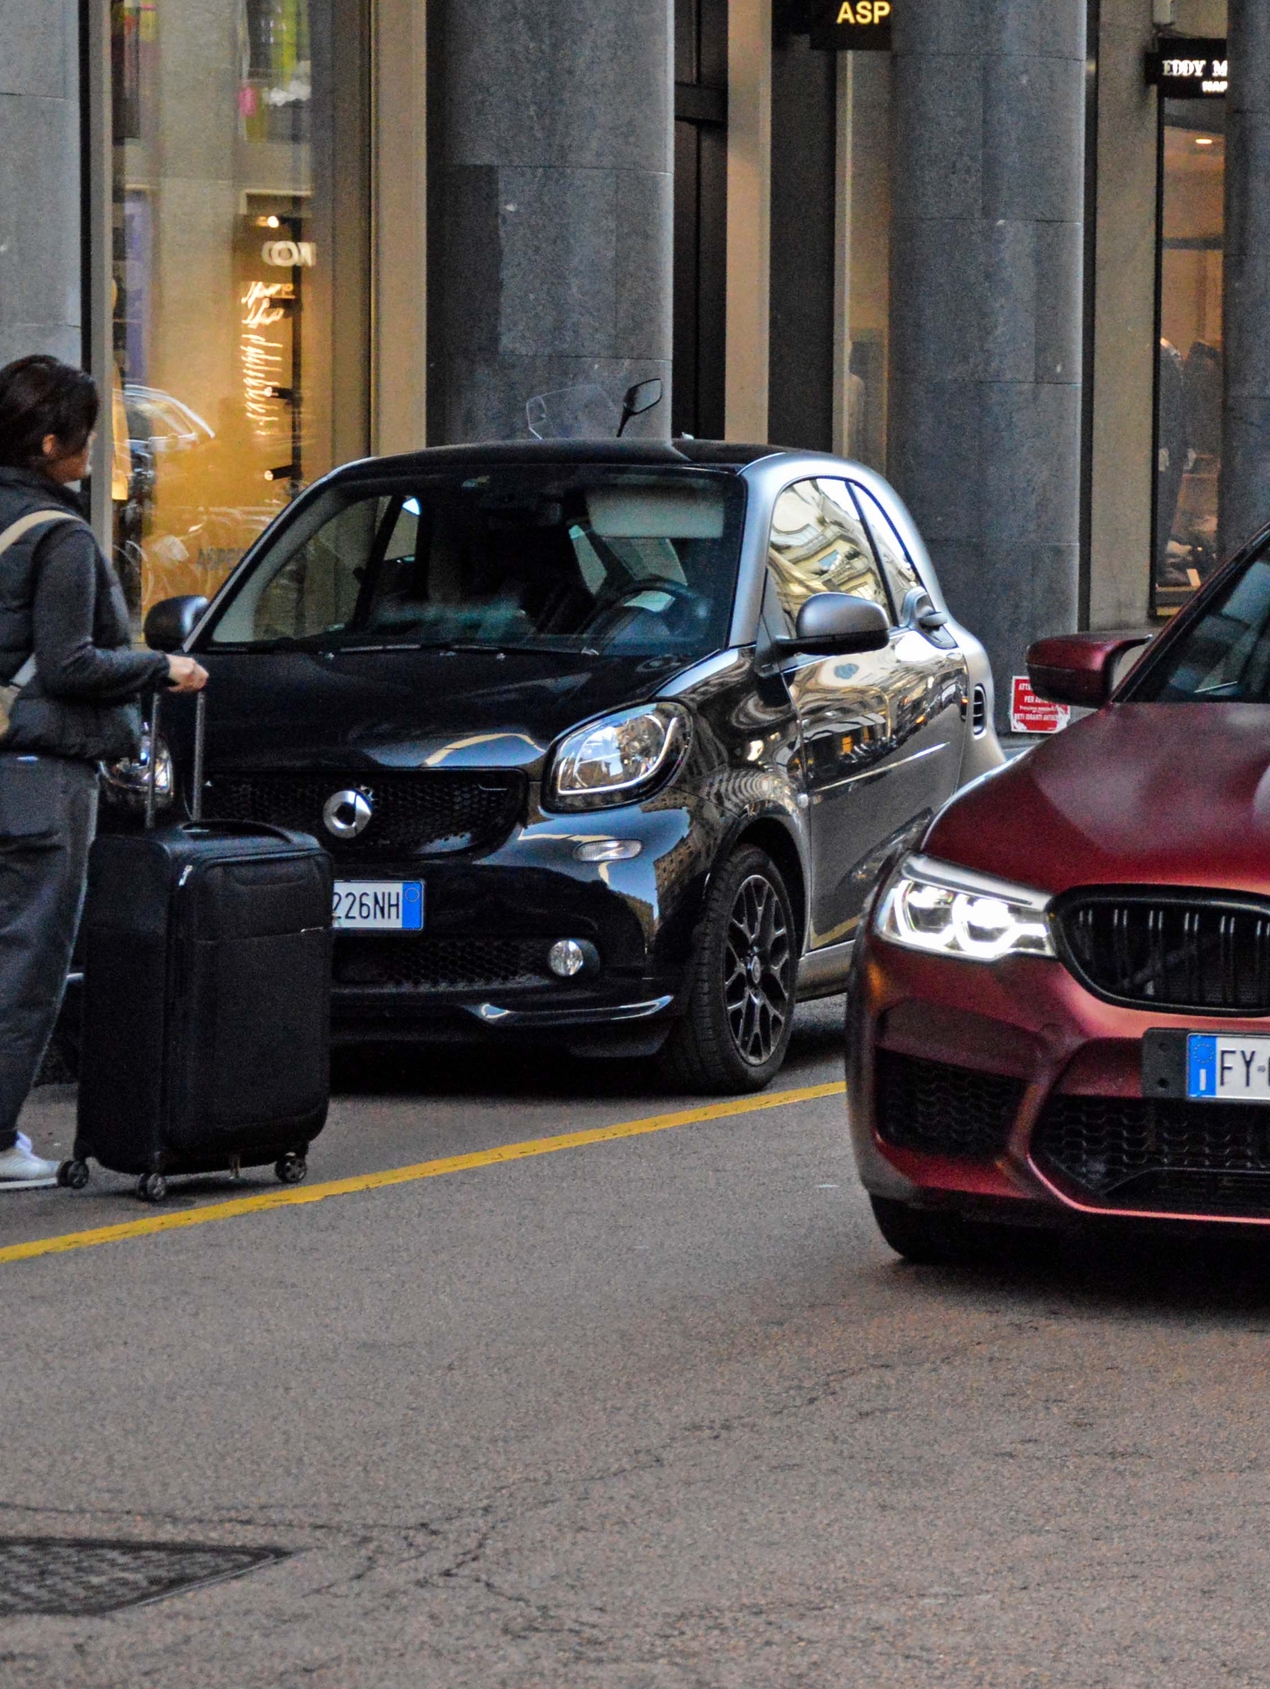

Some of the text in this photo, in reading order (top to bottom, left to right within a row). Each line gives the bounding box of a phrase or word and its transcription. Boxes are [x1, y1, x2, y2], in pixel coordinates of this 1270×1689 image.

[836, 1, 891, 24] ASP
[1162, 60, 1206, 77] EDDY
[333, 891, 400, 920] 226NH
